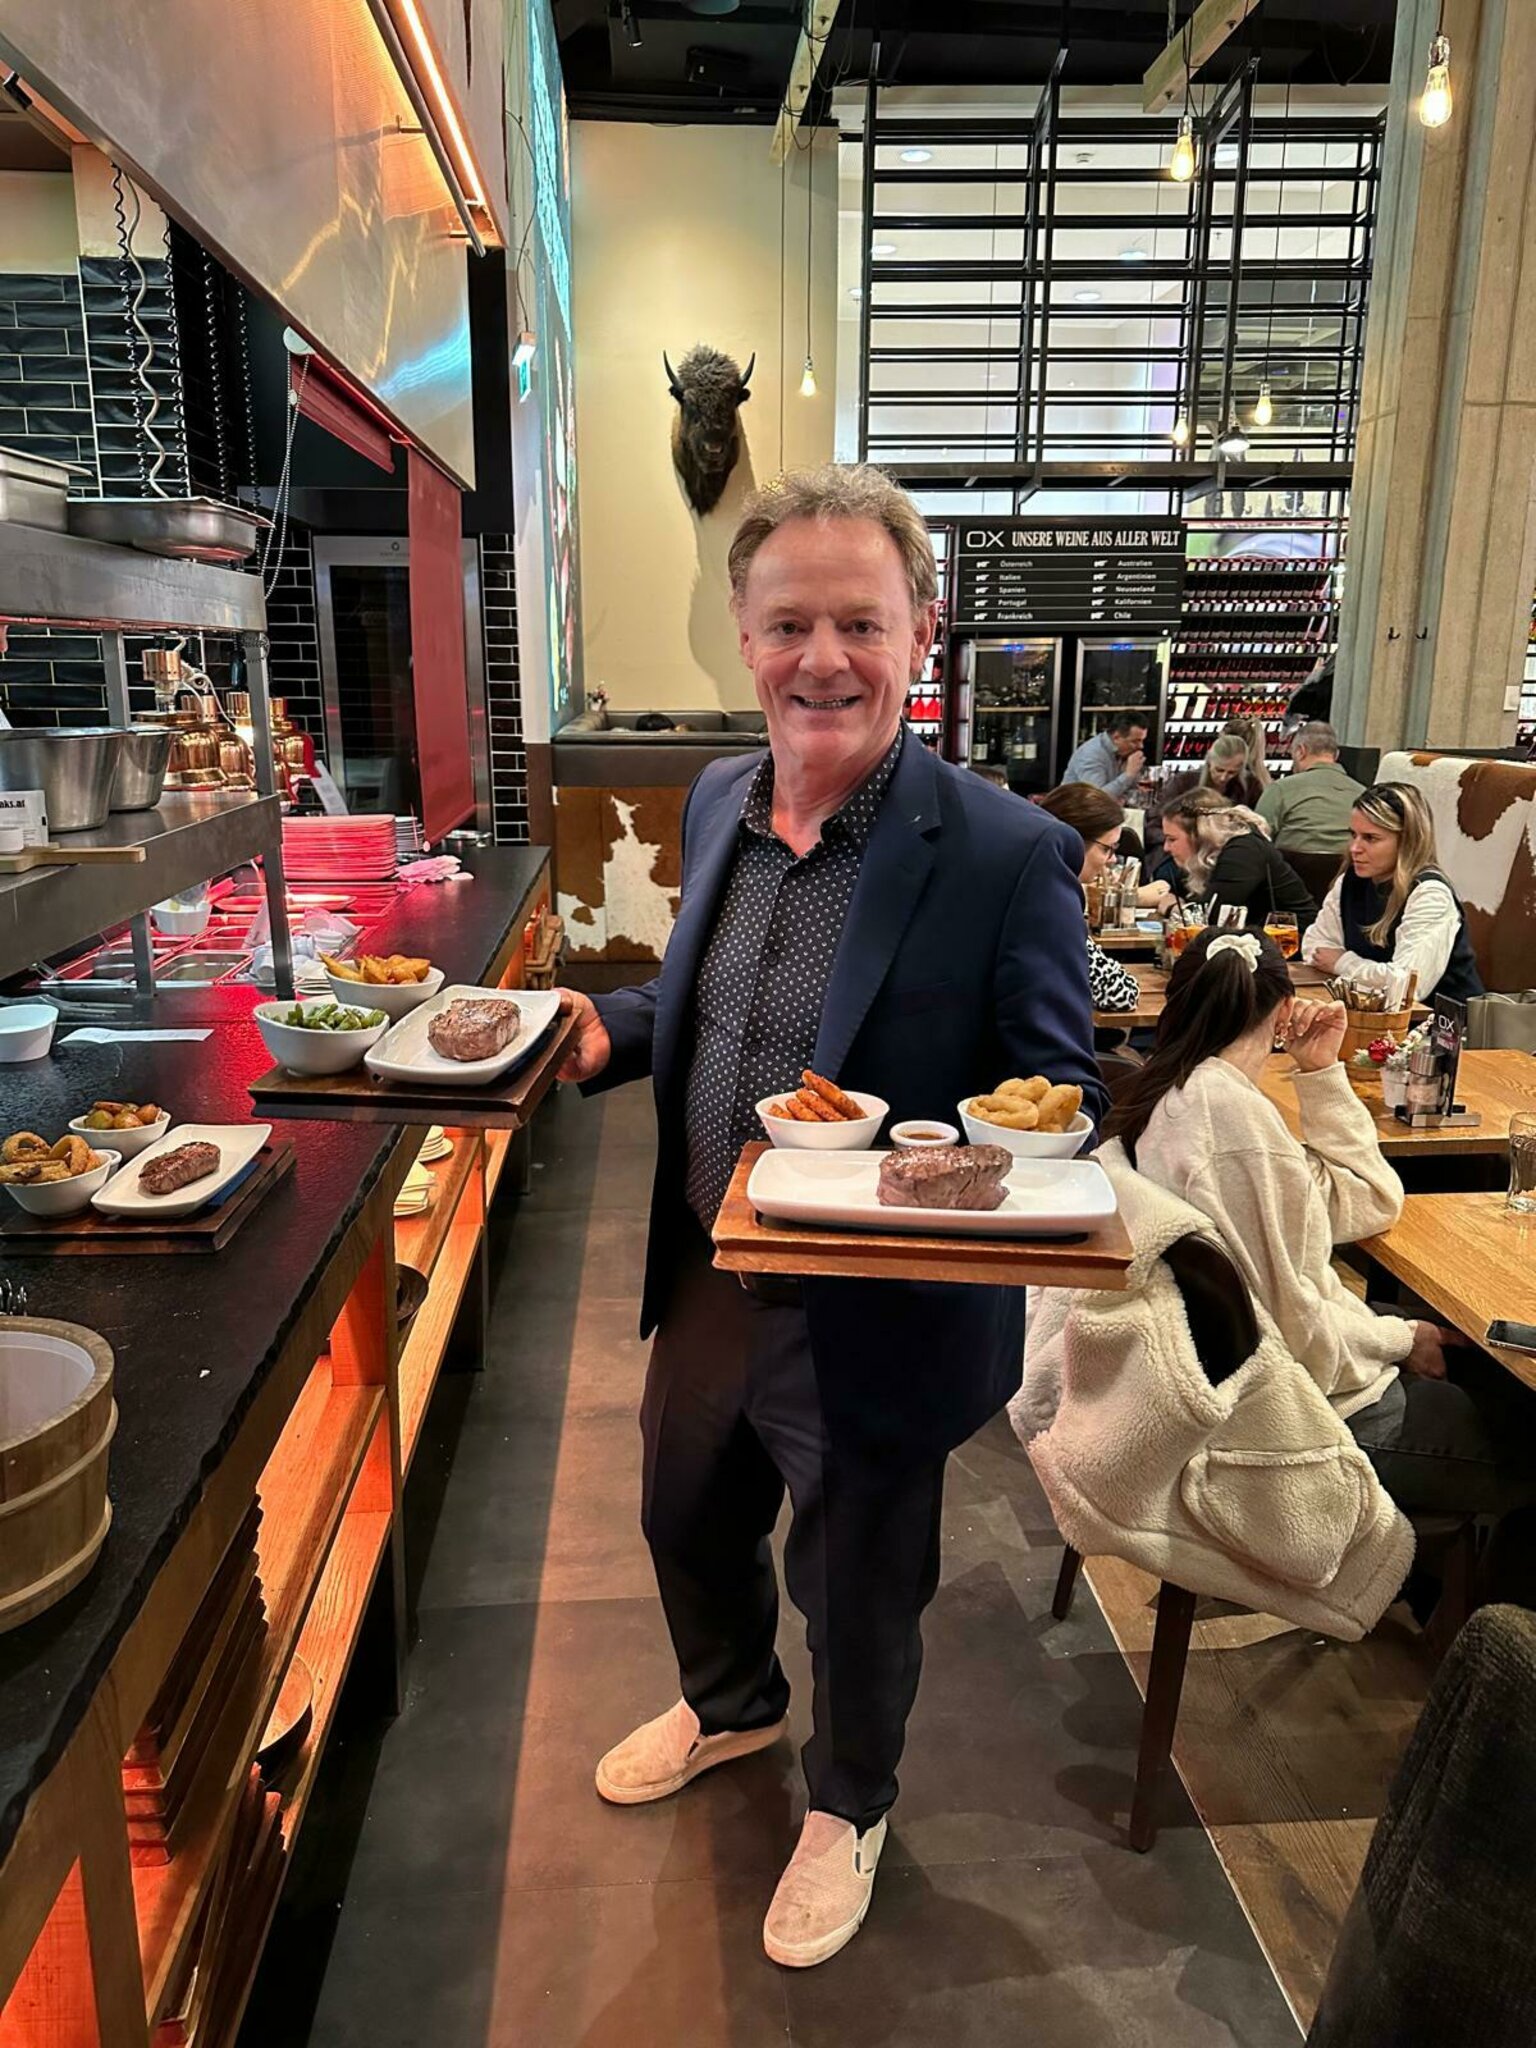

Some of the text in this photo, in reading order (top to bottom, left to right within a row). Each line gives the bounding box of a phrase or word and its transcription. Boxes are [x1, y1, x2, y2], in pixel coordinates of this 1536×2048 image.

[966, 530, 1005, 548] OX
[1011, 530, 1181, 547] UNSERE WEINE AUS ALLER WELT
[1116, 573, 1157, 581] Argentinien
[998, 587, 1026, 595] Spanien
[998, 599, 1027, 607] Portugal
[1114, 598, 1152, 606] Kalifornien
[997, 612, 1033, 620] Frankreich
[1113, 611, 1132, 619] Chile
[1438, 1014, 1455, 1033] OX
